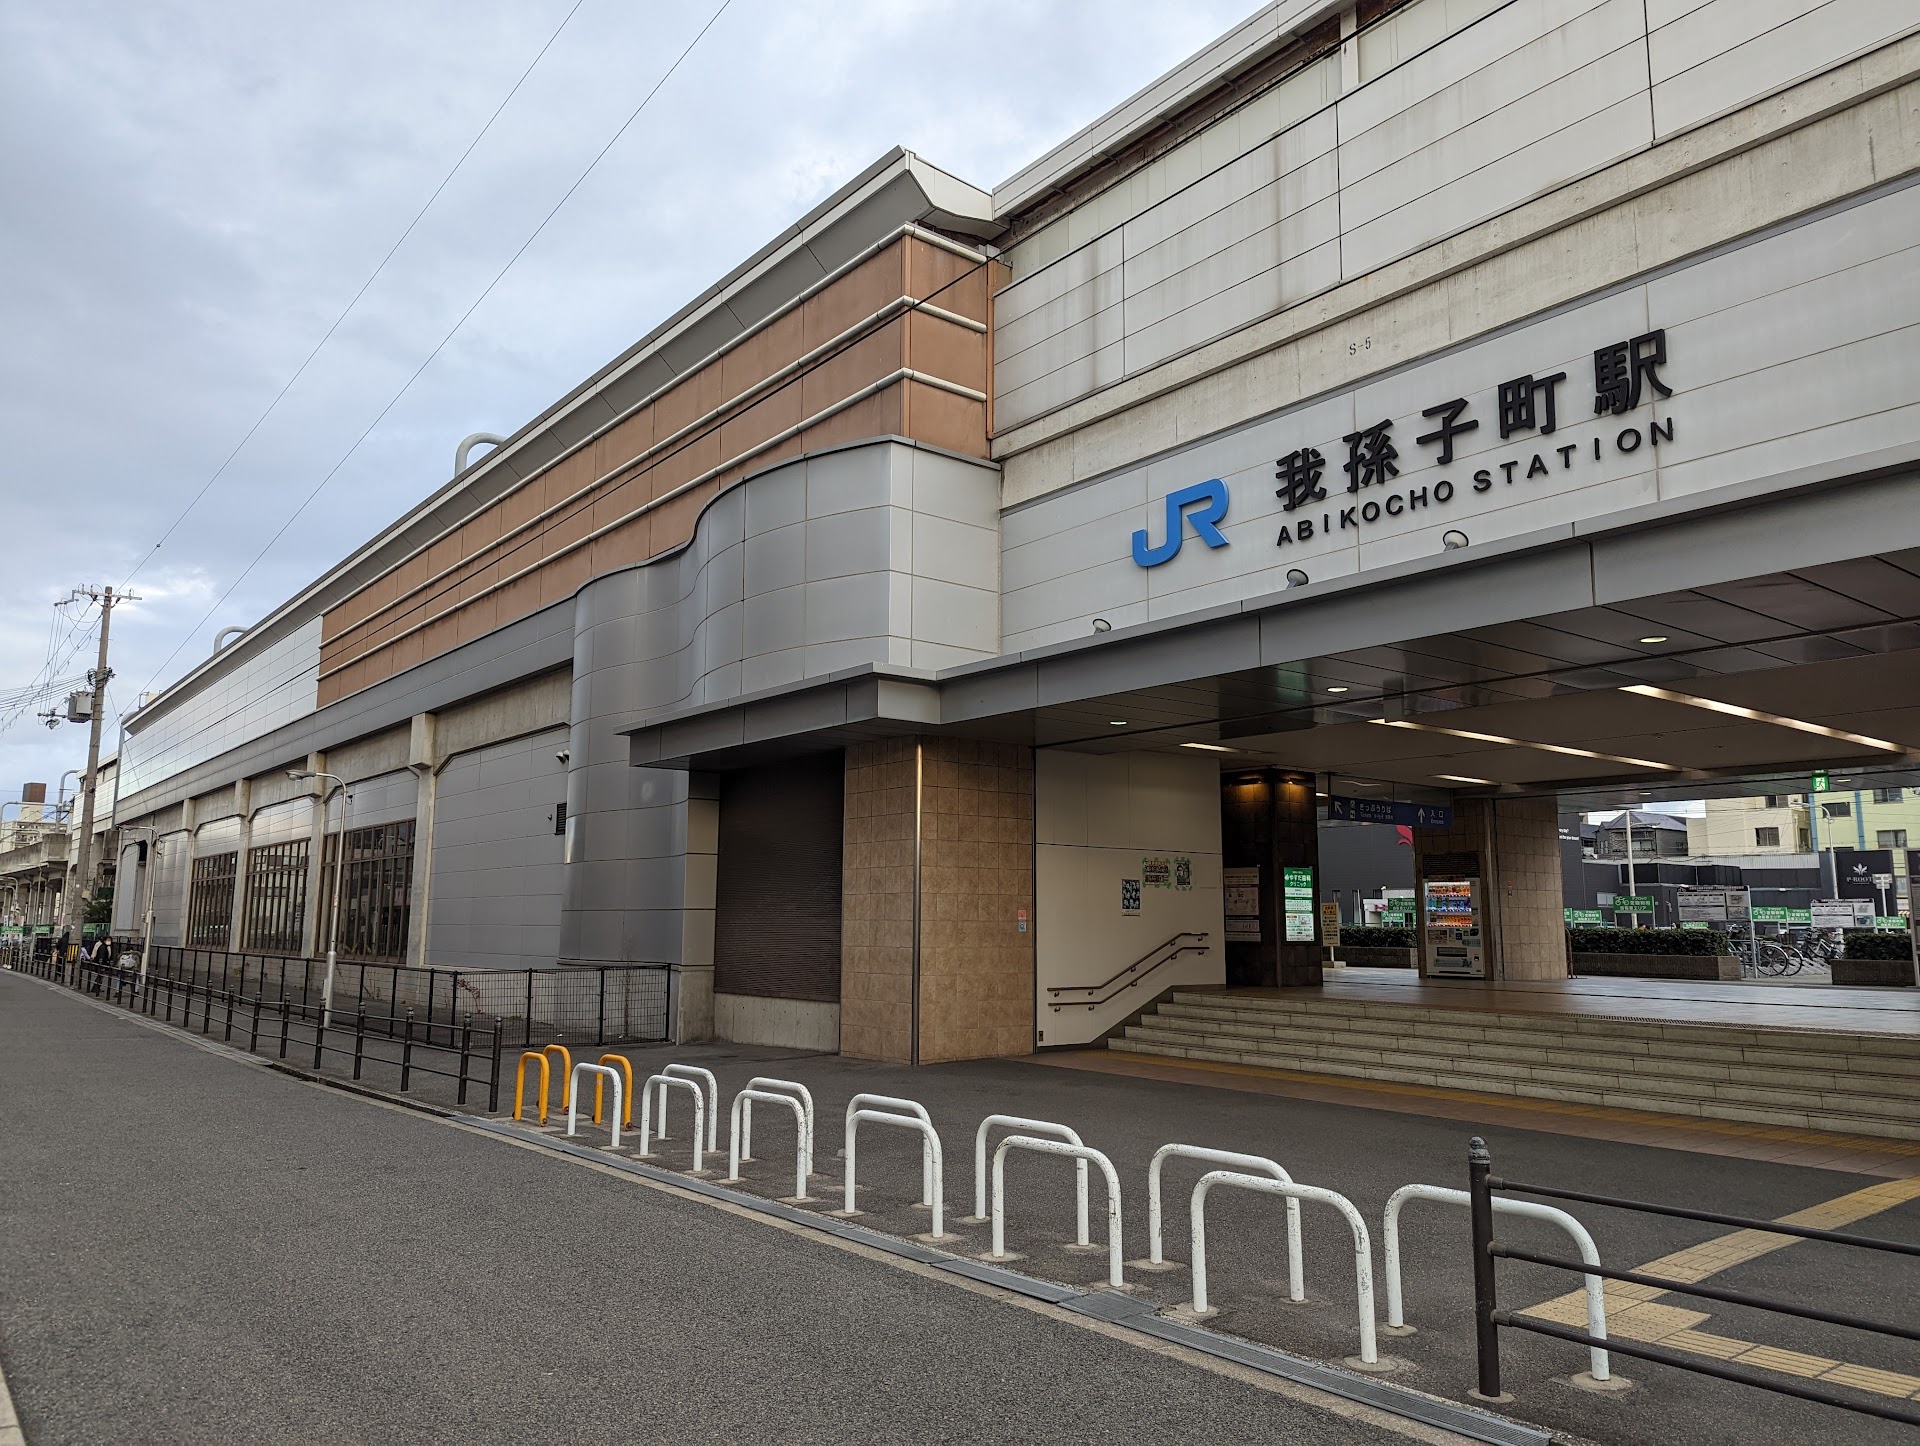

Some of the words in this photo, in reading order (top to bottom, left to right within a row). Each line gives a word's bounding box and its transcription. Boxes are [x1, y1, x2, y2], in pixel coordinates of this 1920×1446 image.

[1349, 336, 1371, 356] S-5
[1274, 328, 1674, 512] 我孫子町駅
[1275, 480, 1454, 547] ABIKOCHO
[1472, 416, 1674, 492] STATION
[1131, 477, 1230, 567] JR
[1359, 803, 1392, 814] きっぷうりば
[1430, 809, 1444, 818] 入口
